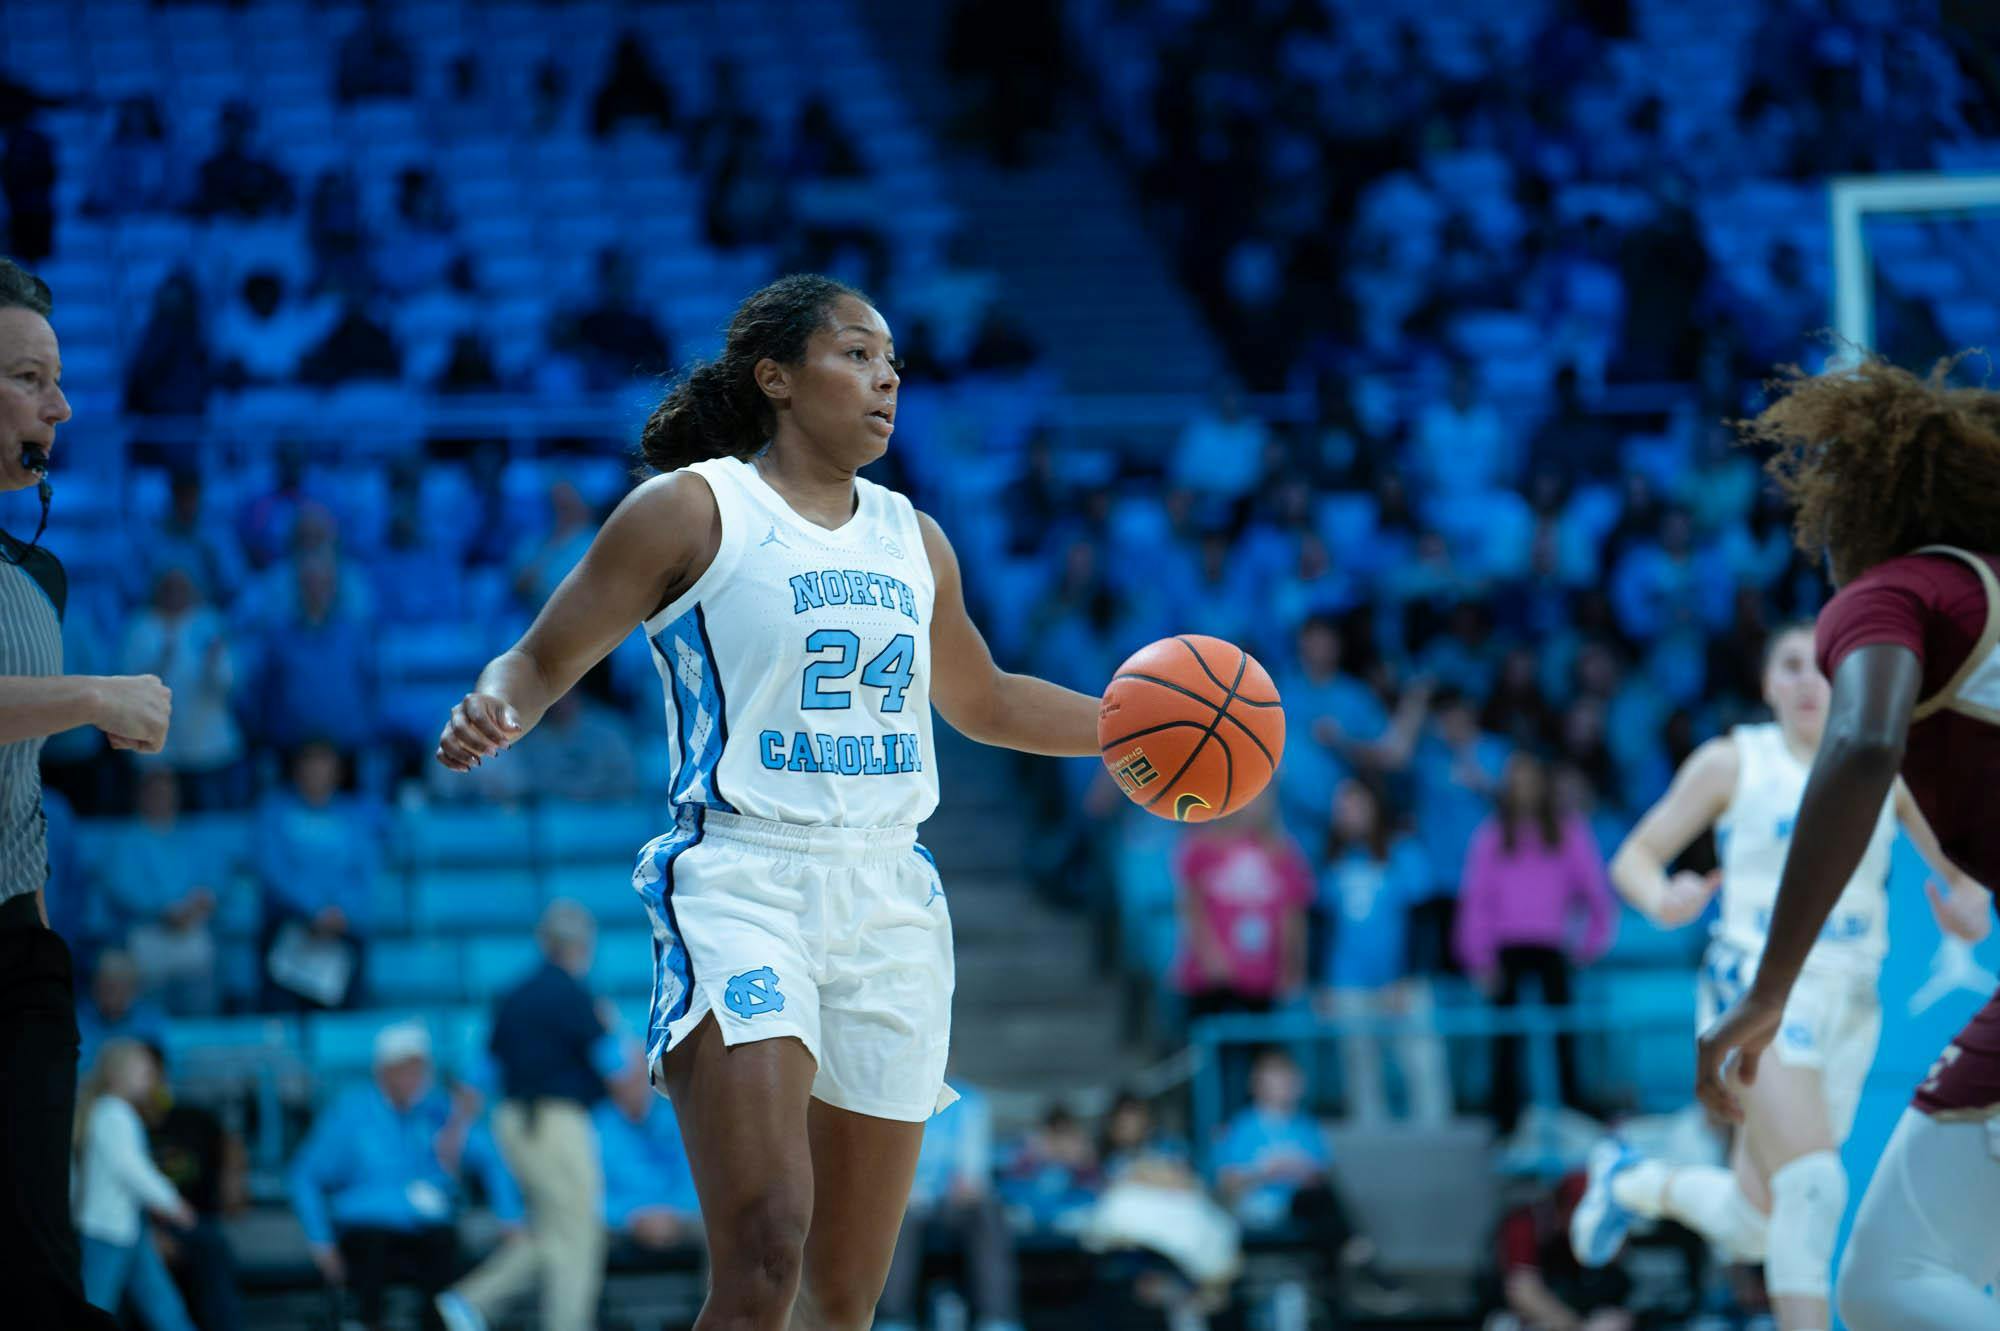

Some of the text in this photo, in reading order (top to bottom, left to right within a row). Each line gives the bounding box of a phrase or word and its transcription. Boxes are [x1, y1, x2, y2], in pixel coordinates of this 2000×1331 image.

[789, 569, 919, 625] NORTH
[801, 629, 915, 713] 24
[759, 729, 922, 776] CAROLIN
